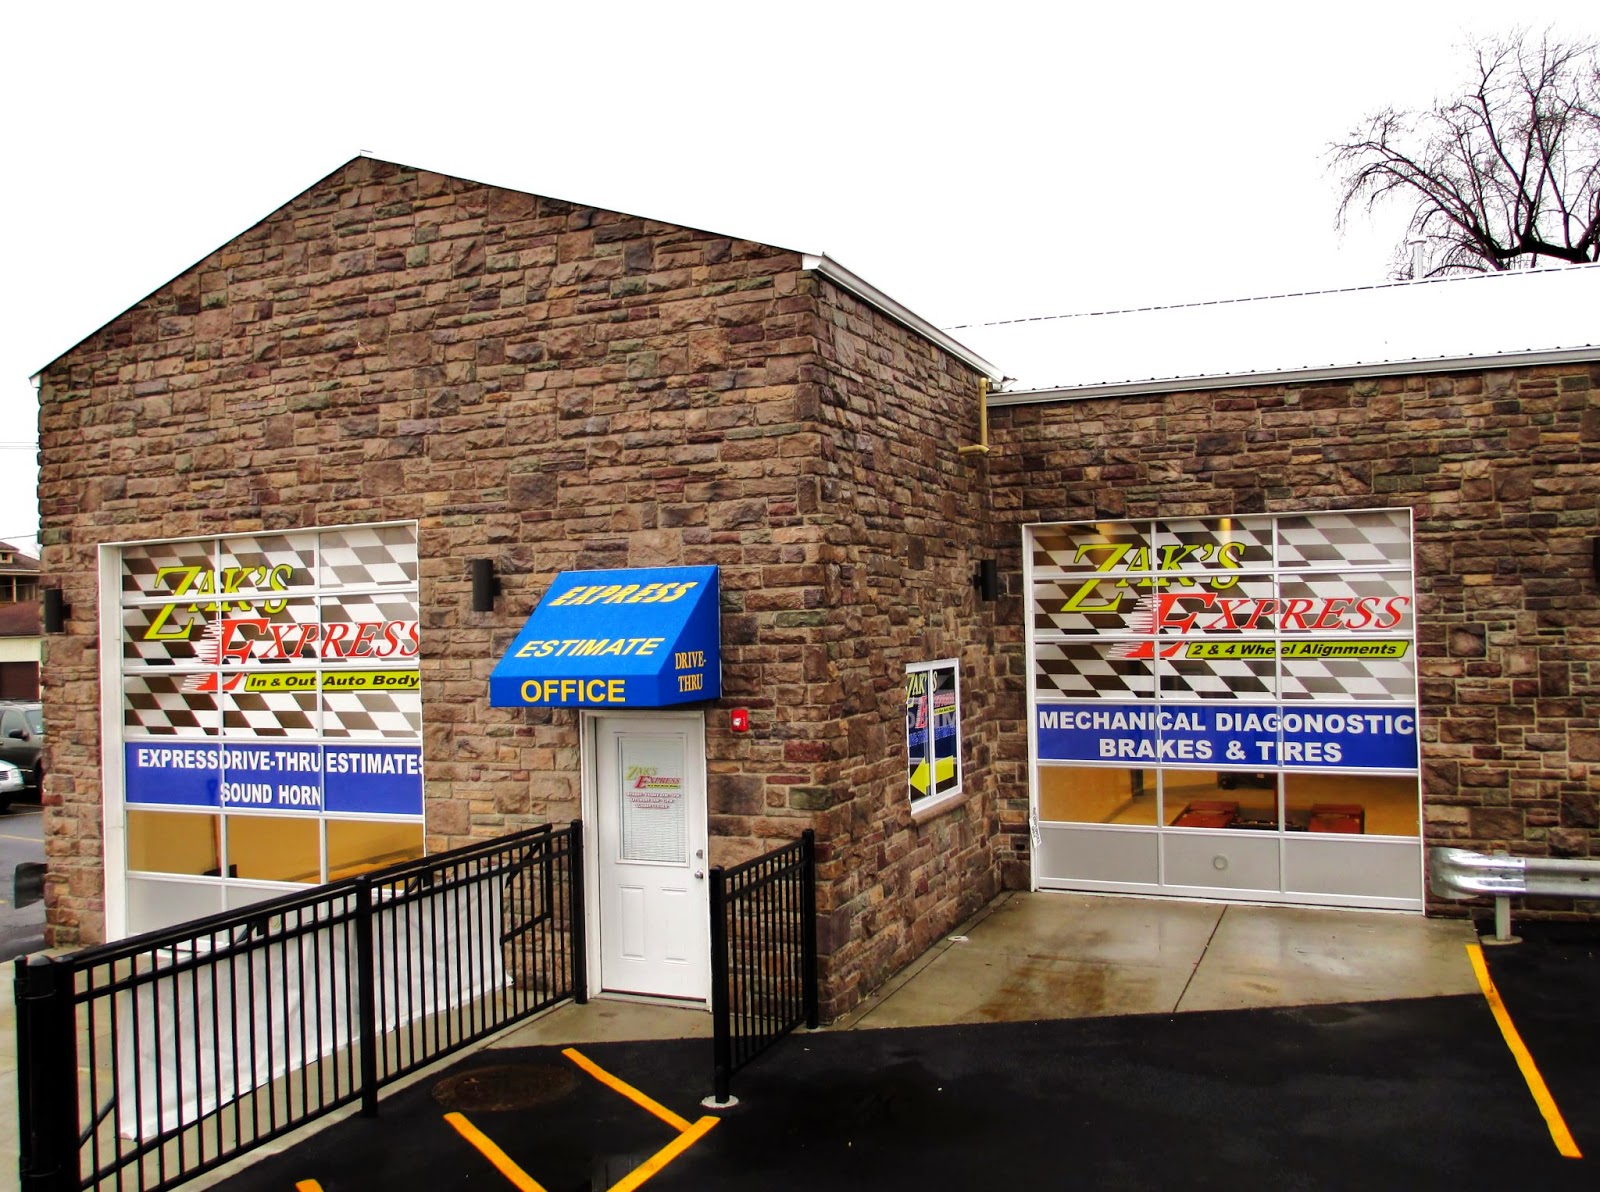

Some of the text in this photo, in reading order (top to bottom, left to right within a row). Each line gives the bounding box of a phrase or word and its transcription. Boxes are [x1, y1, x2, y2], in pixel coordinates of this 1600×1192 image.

[1060, 541, 1244, 613] ZAK'S
[143, 564, 293, 640] ZAK'S
[547, 581, 698, 607] EXPRESS
[1125, 592, 1411, 659] EXPRESS
[194, 618, 419, 691] EXPRESS
[514, 637, 665, 658] ESTIMATE
[1192, 643, 1397, 657] 2 & 4 Wheel Alignments
[675, 651, 707, 670] DRIVE-
[250, 675, 420, 688] In & Out Auto Body
[520, 679, 626, 702] OFFICE
[678, 673, 704, 692] THRU
[1039, 711, 1414, 735] MECHANICAL DIAGONOSTIC
[137, 748, 219, 769] EXPRESS
[219, 750, 321, 772] DRIVE-THRU
[1099, 738, 1342, 762] BRAKES & TIRES
[220, 782, 321, 806] SOUND HORN
